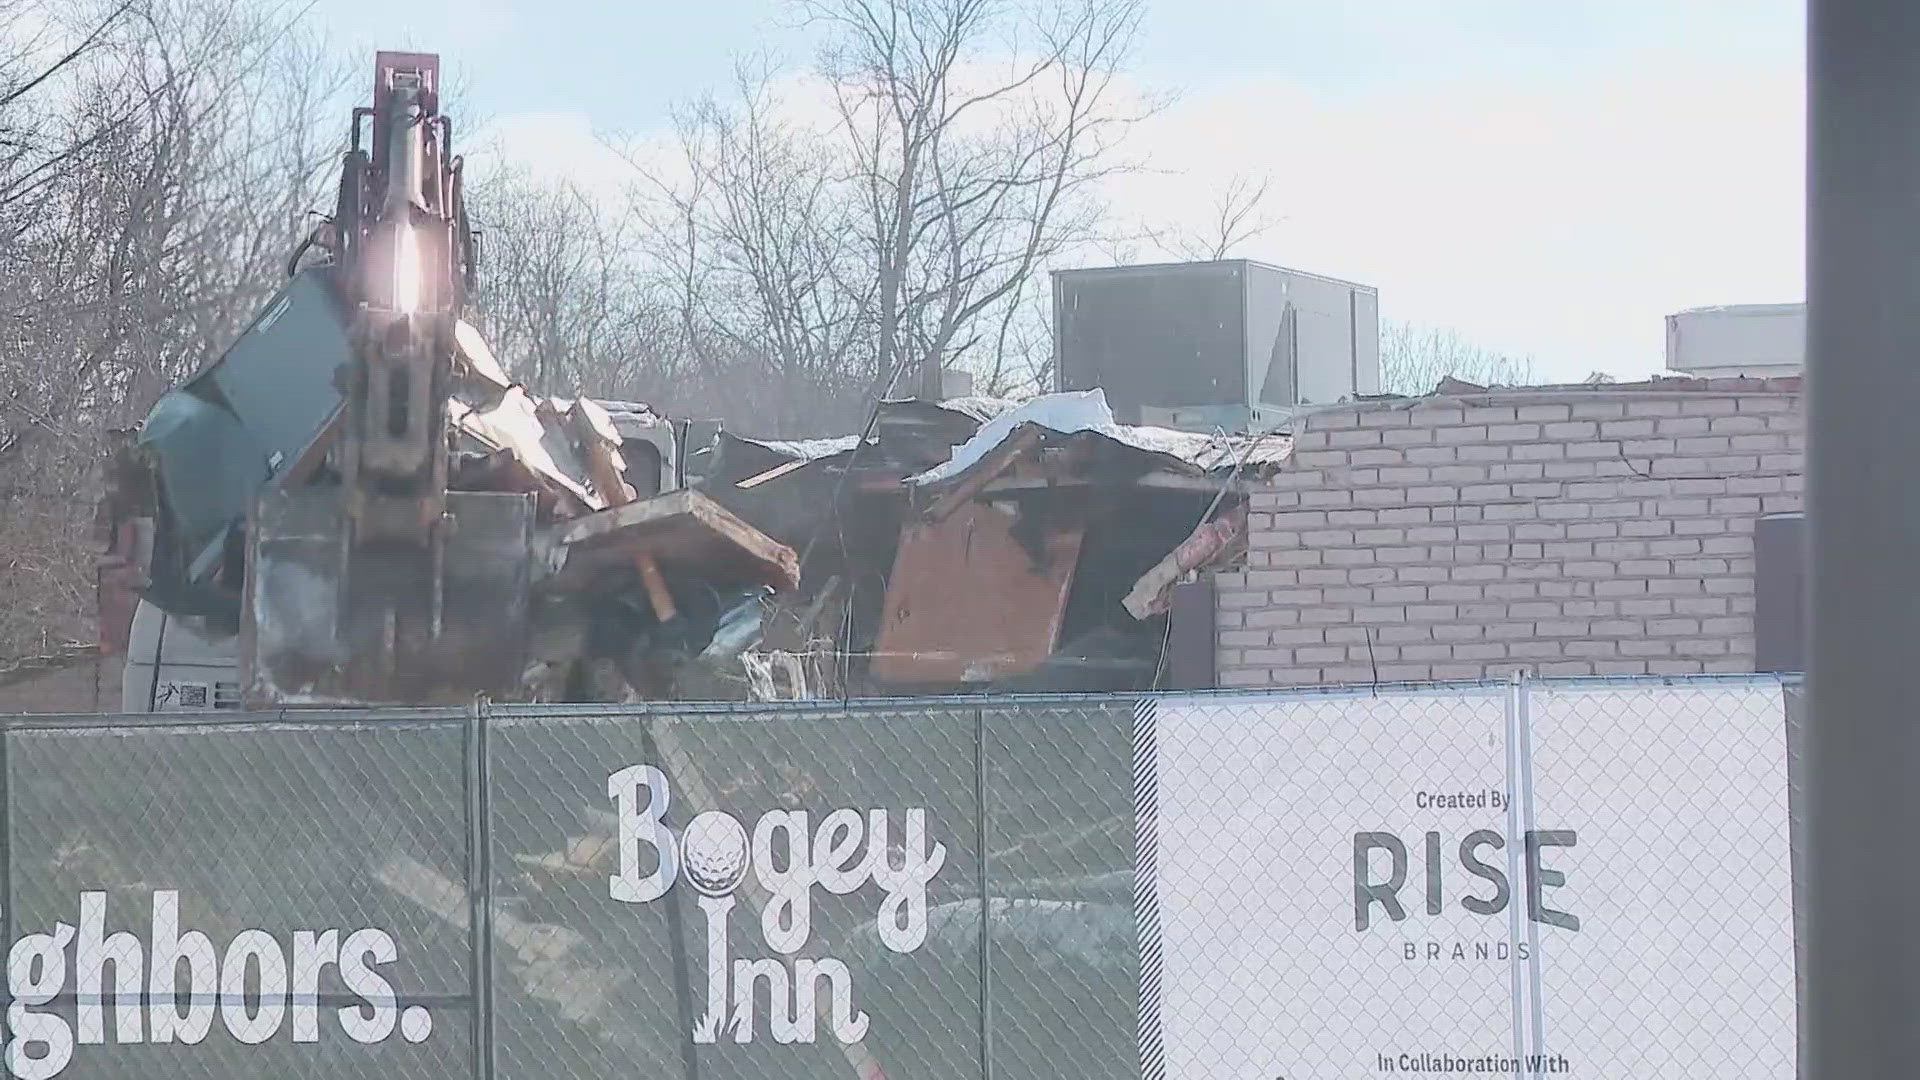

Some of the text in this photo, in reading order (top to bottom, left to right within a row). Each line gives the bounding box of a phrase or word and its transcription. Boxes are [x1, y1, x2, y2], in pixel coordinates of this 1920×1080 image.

[1416, 791, 1510, 813] Created By
[608, 764, 947, 953] Bogey
[1354, 829, 1580, 932] RISE
[0, 890, 433, 1080] ghbors.
[692, 896, 870, 1044] Inn
[1404, 942, 1531, 960] BRANDS
[1378, 1053, 1570, 1073] In Collaboration With
